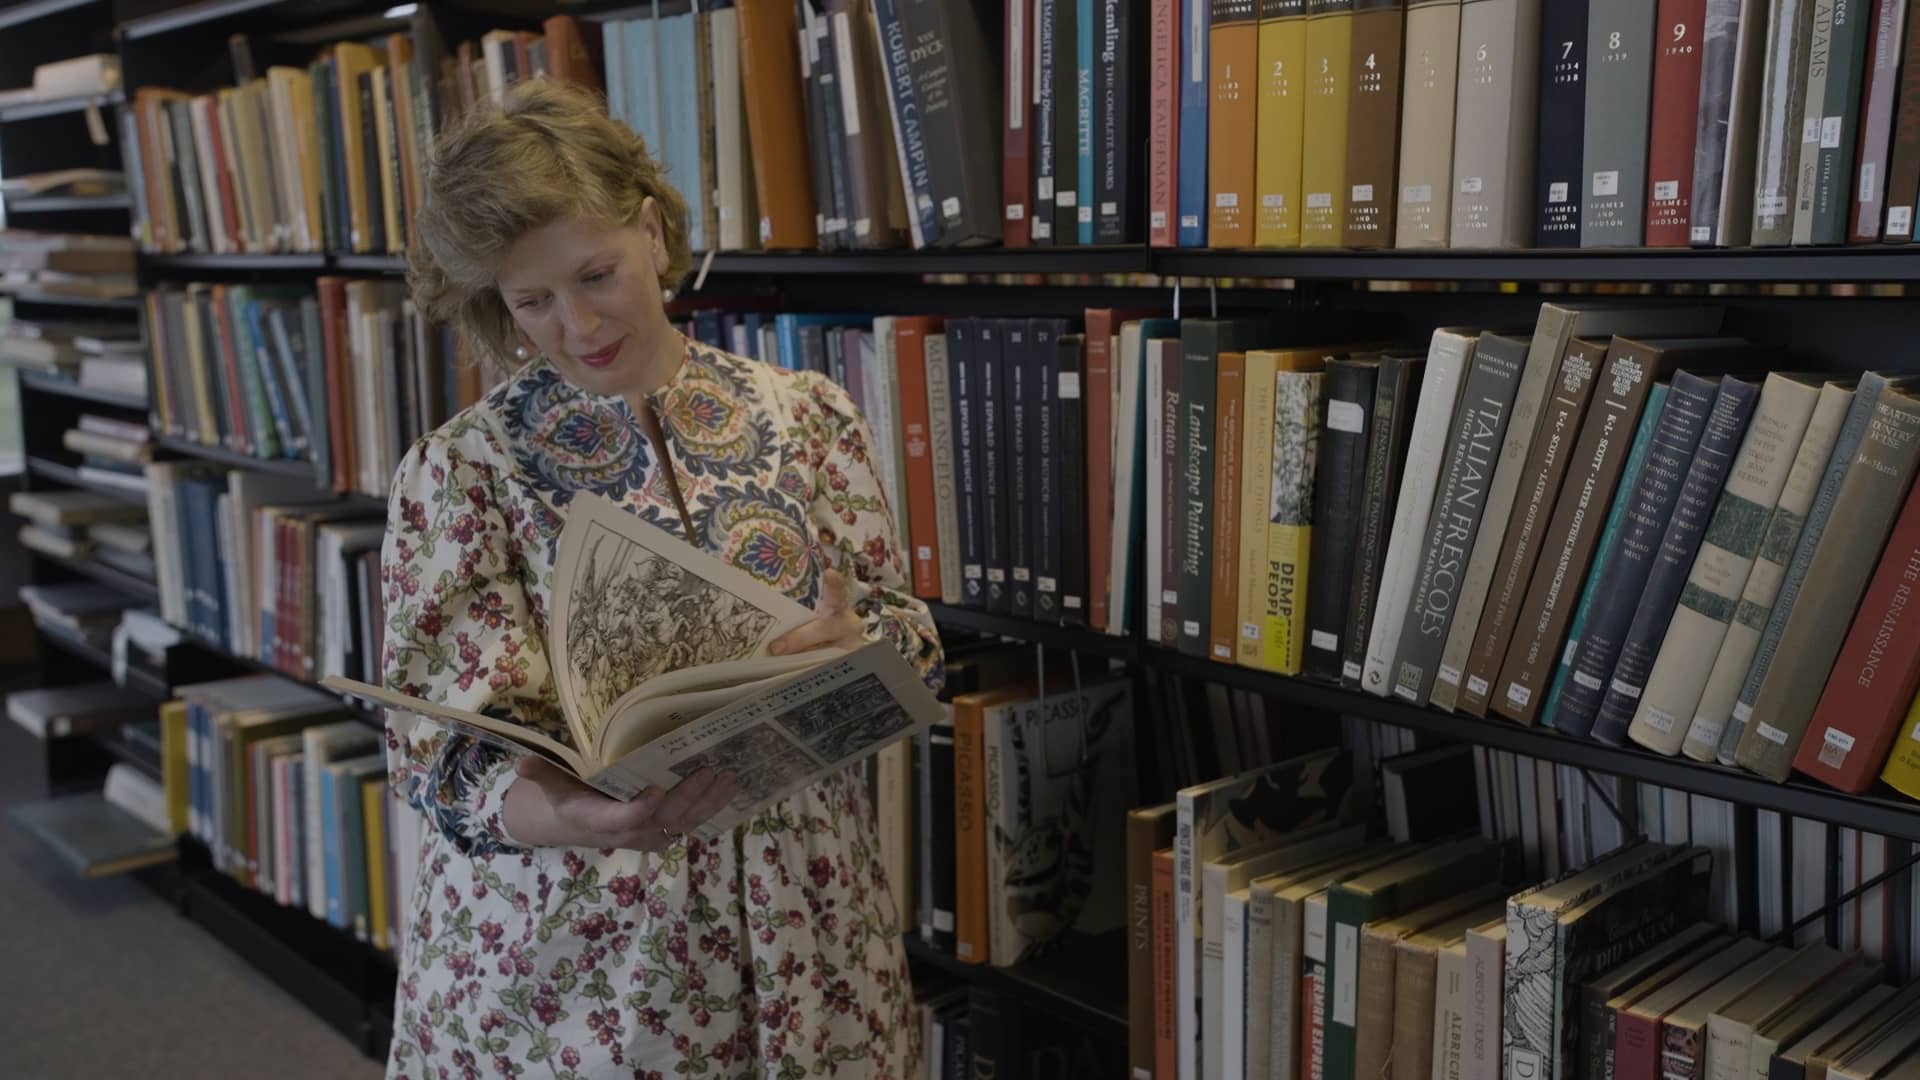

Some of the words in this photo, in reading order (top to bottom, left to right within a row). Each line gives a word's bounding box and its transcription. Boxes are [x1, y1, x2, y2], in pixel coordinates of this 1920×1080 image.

[1103, 0, 1119, 63] emling
[1156, 0, 1168, 90] NGELICA
[1476, 44, 1487, 61] 6
[1562, 41, 1573, 60] 7
[1608, 31, 1621, 49] 8
[1666, 45, 1693, 56] 1940
[1672, 23, 1686, 42] 9
[1809, 4, 1832, 80] ADAMS
[1273, 61, 1283, 76] 2
[1360, 73, 1381, 81] 1923
[1365, 53, 1376, 70] 4
[1554, 62, 1579, 72] 1934
[1554, 72, 1579, 83] 1938
[1601, 52, 1628, 63] 1939
[886, 20, 913, 100] ROBERT
[902, 103, 929, 188] CAMPIN
[1079, 69, 1090, 157] MAGRITTE
[1105, 90, 1114, 149] COMPLETE
[1544, 206, 1577, 214] THAMES
[1590, 201, 1624, 209] THAMES
[1652, 199, 1688, 207] THAMES
[927, 338, 953, 502] MICHELANGELO
[958, 399, 971, 447] EDVARD
[982, 400, 997, 448] EDVARD
[1012, 404, 1026, 453] EDVARD
[1038, 405, 1053, 454] EDVARD
[1162, 389, 1180, 456] Retratos
[1460, 408, 1476, 440] HIGH
[961, 448, 974, 493] MUNCH
[1183, 400, 1210, 496] Landscape
[1371, 419, 1391, 497] RENAISSANCE
[1454, 396, 1504, 509] ITALIAN
[1542, 433, 1561, 467] SCOTT
[1589, 437, 1609, 472] SCOTT
[984, 450, 998, 496] MUNCH
[1013, 455, 1027, 502] MUNCH
[1038, 456, 1054, 503] MUNCH
[1438, 442, 1467, 520] RENAISSANCE
[1530, 472, 1549, 505] LATER
[1577, 477, 1596, 510] LATER
[1183, 499, 1207, 577] Painting
[1365, 501, 1381, 557] PAINTING
[1431, 521, 1446, 546] AND
[1565, 508, 1586, 547] GOTHIC
[1363, 559, 1373, 573] IN
[1413, 546, 1438, 615] MANNERISM
[1418, 511, 1473, 640] FRESCOES
[1543, 545, 1573, 611] MANUSCRIPTS
[1902, 548, 1920, 583] THE
[1855, 582, 1912, 690] RENAISSANCE
[1024, 696, 1089, 729] PICASSO
[957, 731, 973, 833] PICASSO
[986, 745, 1000, 811] PICASSO
[1135, 883, 1148, 951] PRINTS
[1313, 964, 1326, 1025] GERMAN
